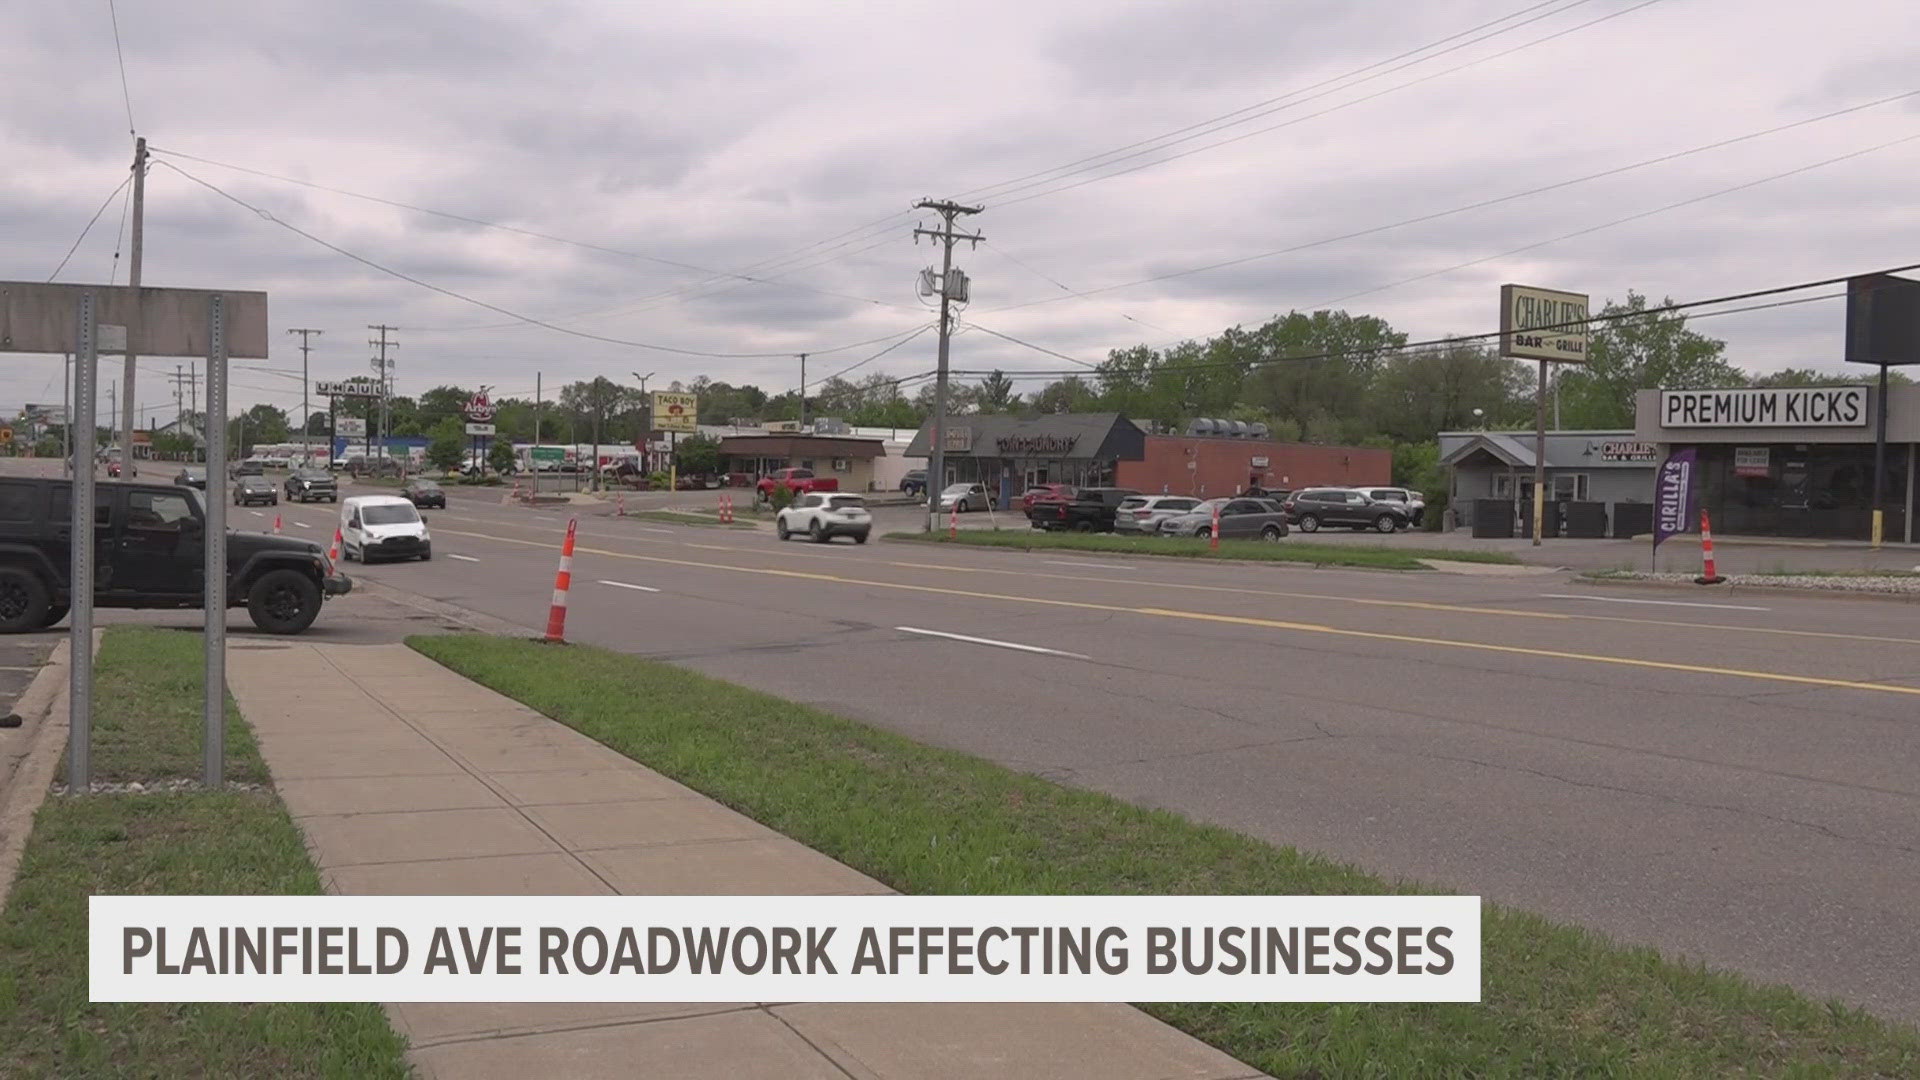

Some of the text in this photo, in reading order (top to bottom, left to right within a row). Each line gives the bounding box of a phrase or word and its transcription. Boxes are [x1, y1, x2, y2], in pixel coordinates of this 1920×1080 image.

[1515, 294, 1585, 335] CHARLIE'S
[1516, 334, 1583, 353] BAR GRILLE
[657, 395, 695, 408] TACO BOY
[1668, 391, 1860, 423] PREMIUM KICKS
[1661, 461, 1681, 532] CIRILLA'S
